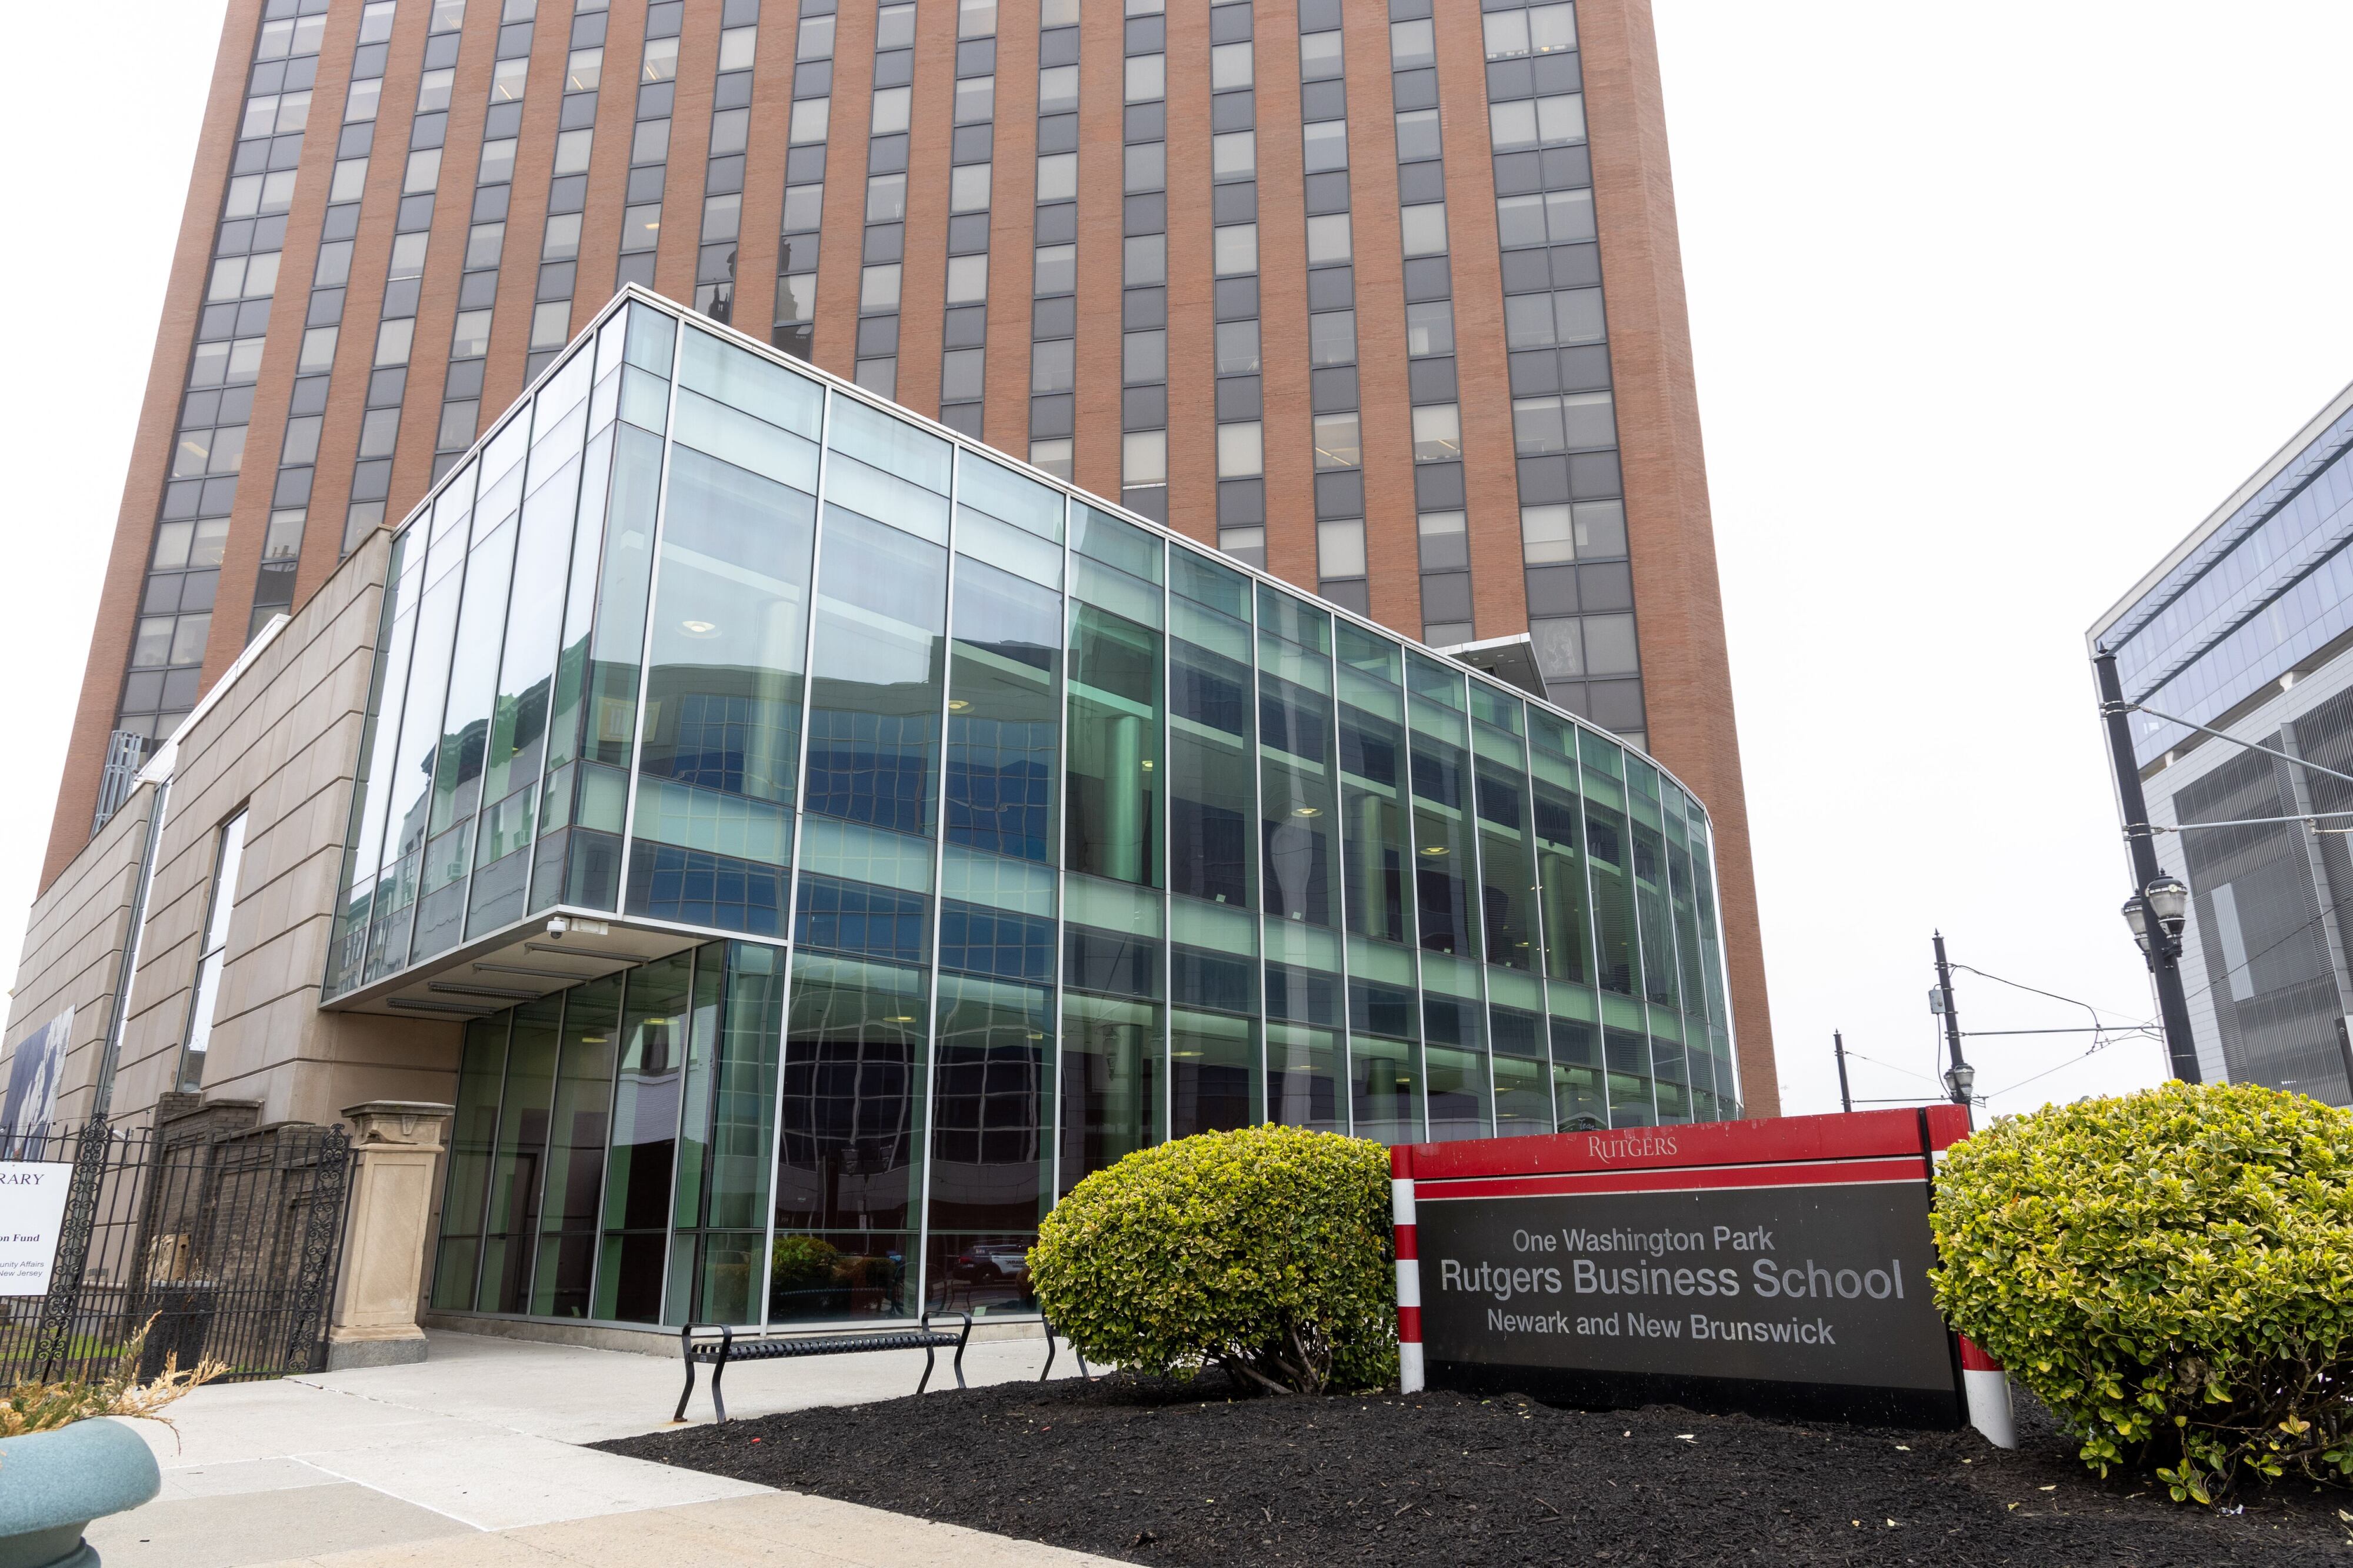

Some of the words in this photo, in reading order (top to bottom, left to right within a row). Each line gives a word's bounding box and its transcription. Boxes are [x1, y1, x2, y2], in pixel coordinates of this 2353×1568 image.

[1513, 1229, 1557, 1252] One
[1562, 1228, 1705, 1257] Washington
[1713, 1226, 1775, 1250] Park
[1441, 1259, 1562, 1300] Rutgers
[1573, 1259, 1739, 1296] Business
[1752, 1258, 1904, 1299] School
[1488, 1309, 1570, 1334] Newark
[1577, 1313, 1619, 1336] and
[1628, 1312, 1681, 1338] New
[1691, 1314, 1836, 1345] Brunswick
